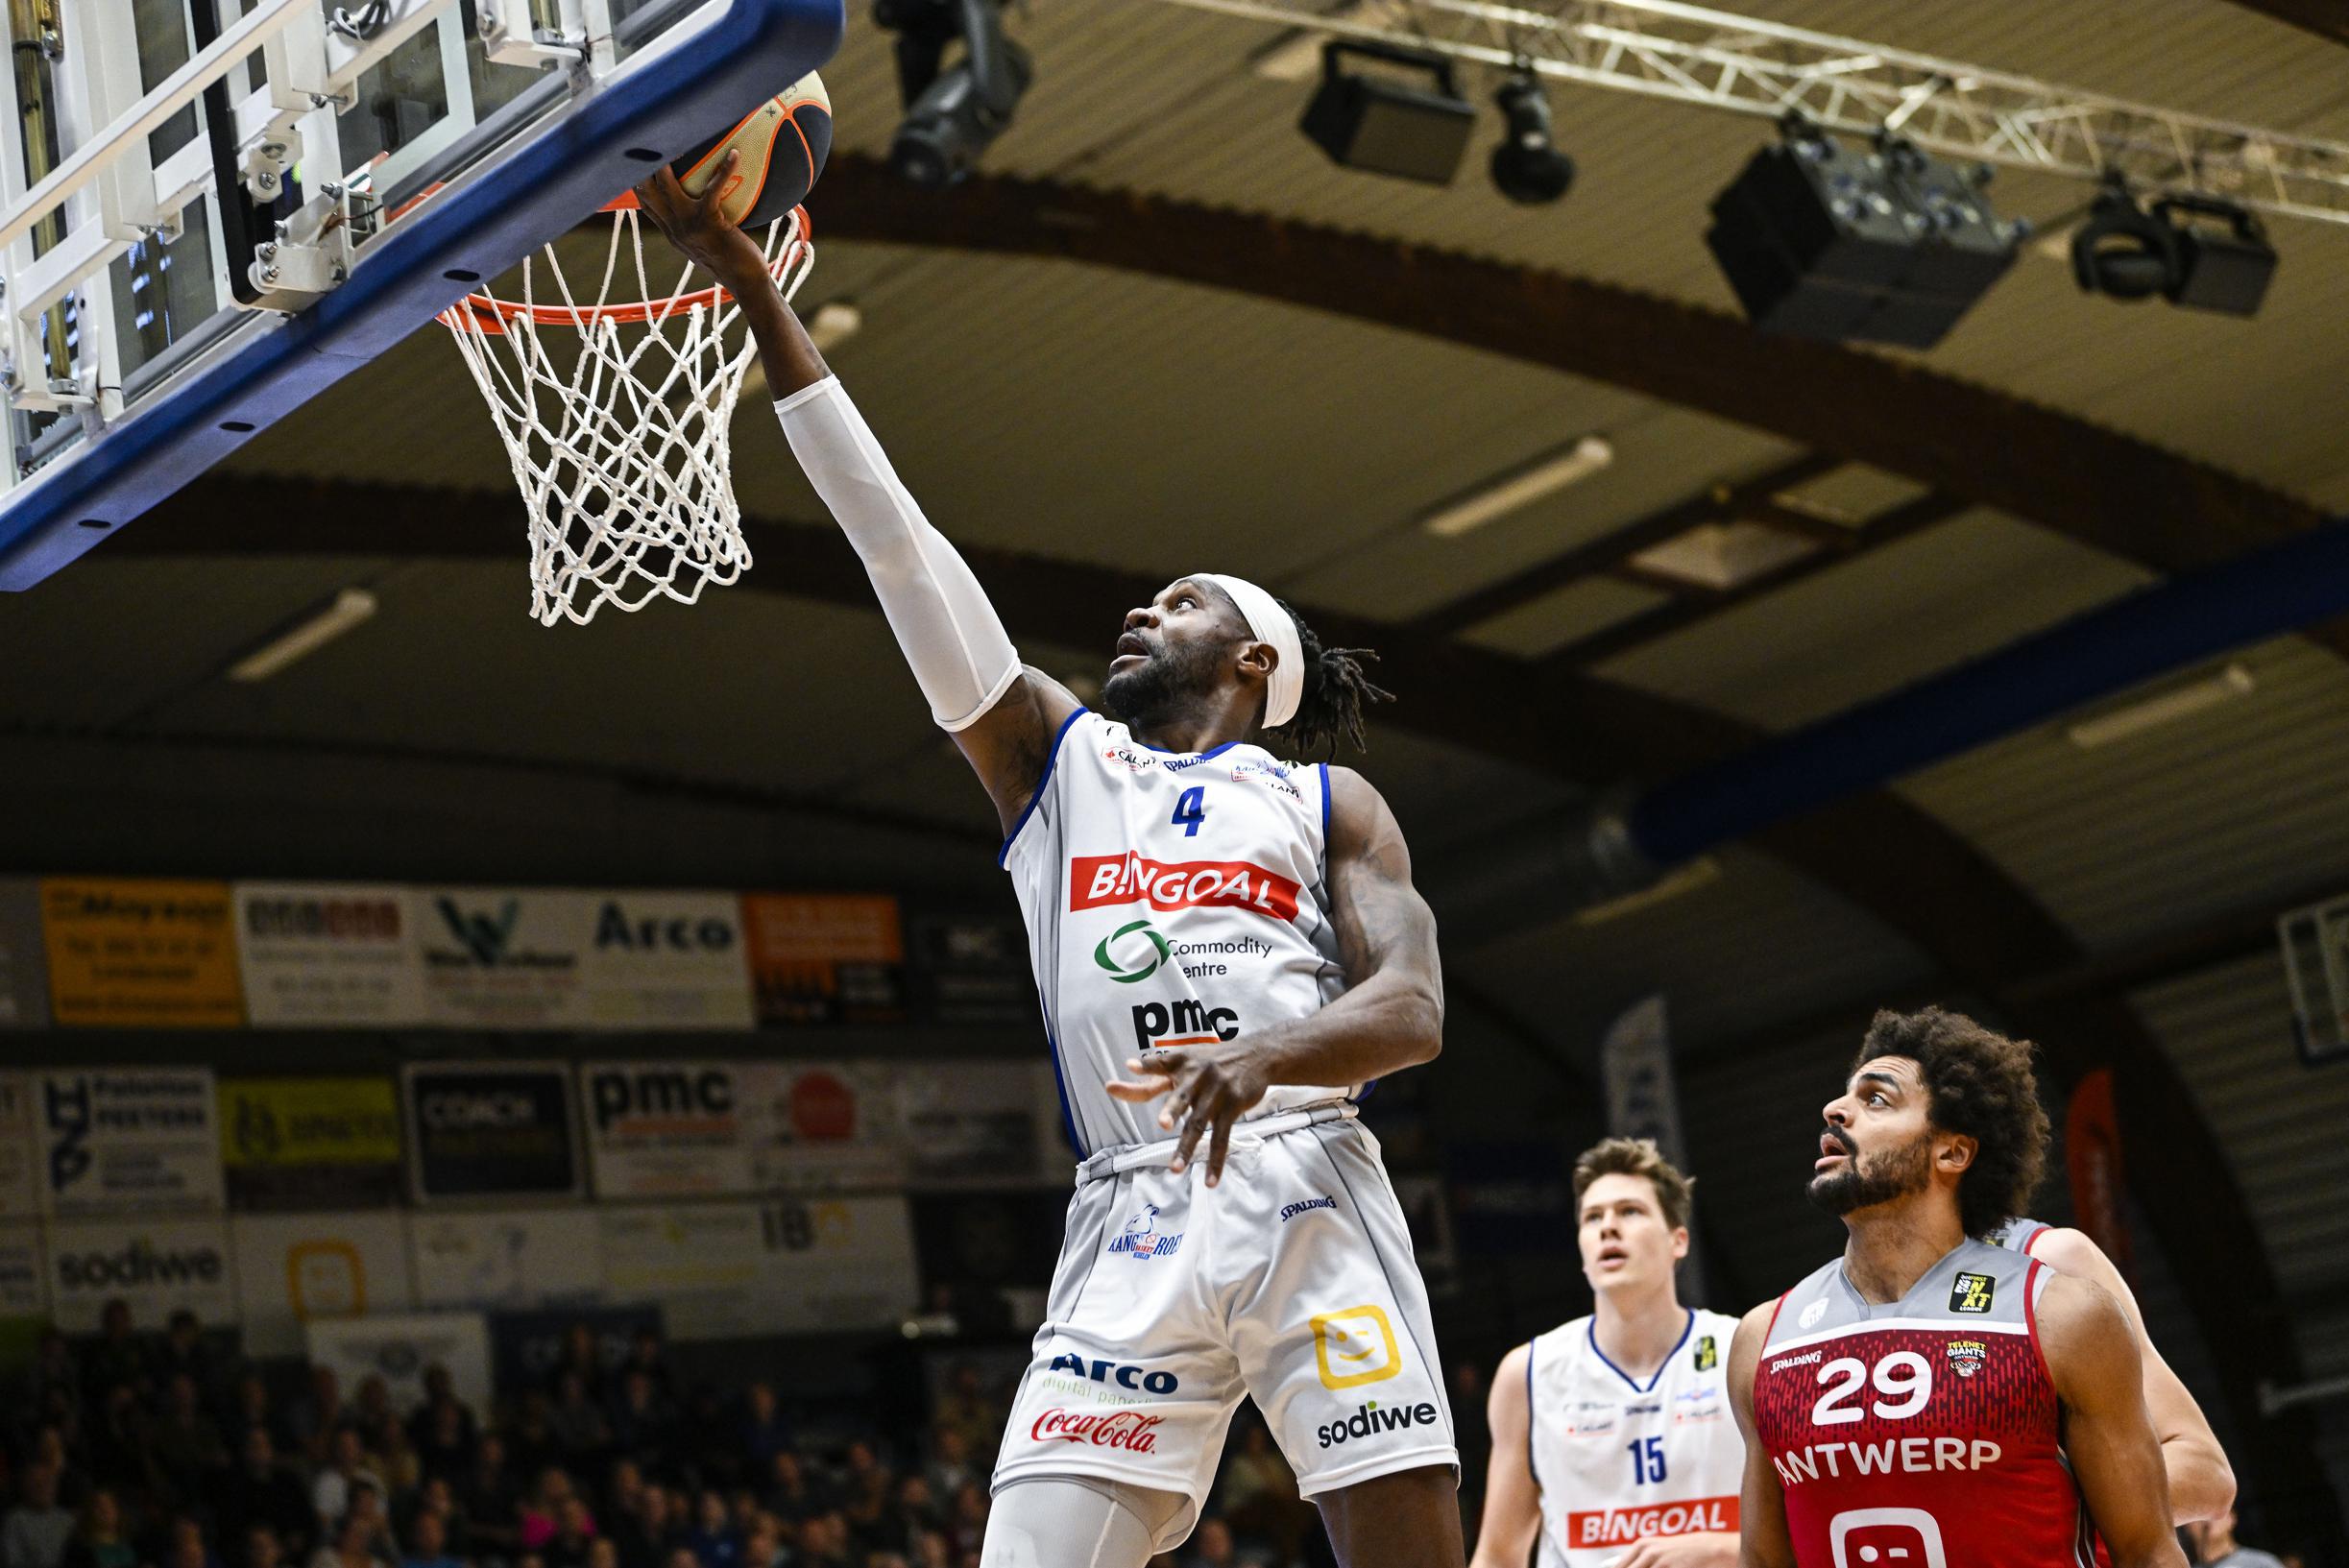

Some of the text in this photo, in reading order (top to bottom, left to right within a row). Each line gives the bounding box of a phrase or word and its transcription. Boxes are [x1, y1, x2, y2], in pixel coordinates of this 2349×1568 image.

[1171, 785, 1205, 837] 4
[595, 901, 733, 952] Arco
[1167, 936, 1272, 958] Commodity
[1182, 961, 1227, 977] entre
[1132, 999, 1239, 1049] pmc
[594, 1072, 732, 1129] pmc
[1281, 1194, 1337, 1222] SPALDING
[60, 1237, 221, 1289] sodiwe
[1770, 1350, 1823, 1374] SPALDING
[1947, 1340, 1986, 1351] TELENET
[1947, 1347, 1986, 1359] GIANTS
[1043, 1376, 1092, 1399] digital
[1049, 1352, 1178, 1394] Arco
[1811, 1351, 1932, 1426] 29
[1031, 1408, 1167, 1454] Coca-Cola
[1317, 1401, 1438, 1449] sodiwe
[1628, 1436, 1667, 1484] 15
[1773, 1437, 2002, 1486] ANTWERP
